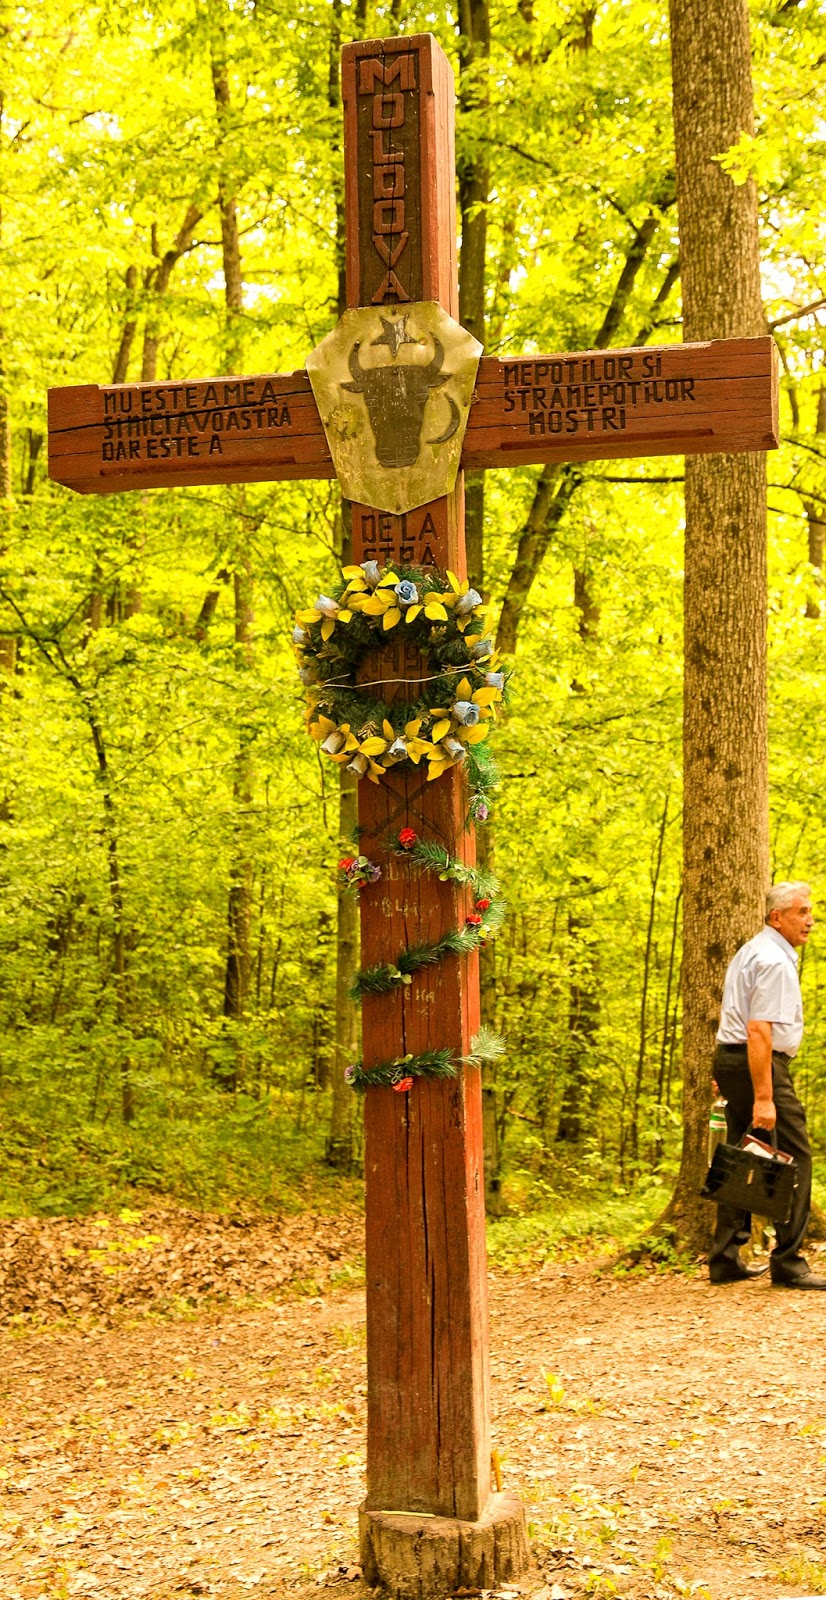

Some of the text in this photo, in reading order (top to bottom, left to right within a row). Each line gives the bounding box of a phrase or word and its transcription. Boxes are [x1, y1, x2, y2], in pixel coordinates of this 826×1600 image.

[358, 54, 416, 304] MOLDOVA
[141, 386, 198, 413] ESTE
[202, 384, 219, 406] A
[224, 381, 278, 405] MEA
[102, 434, 223, 461] DAR ESTE A
[361, 513, 439, 543] DE LA
